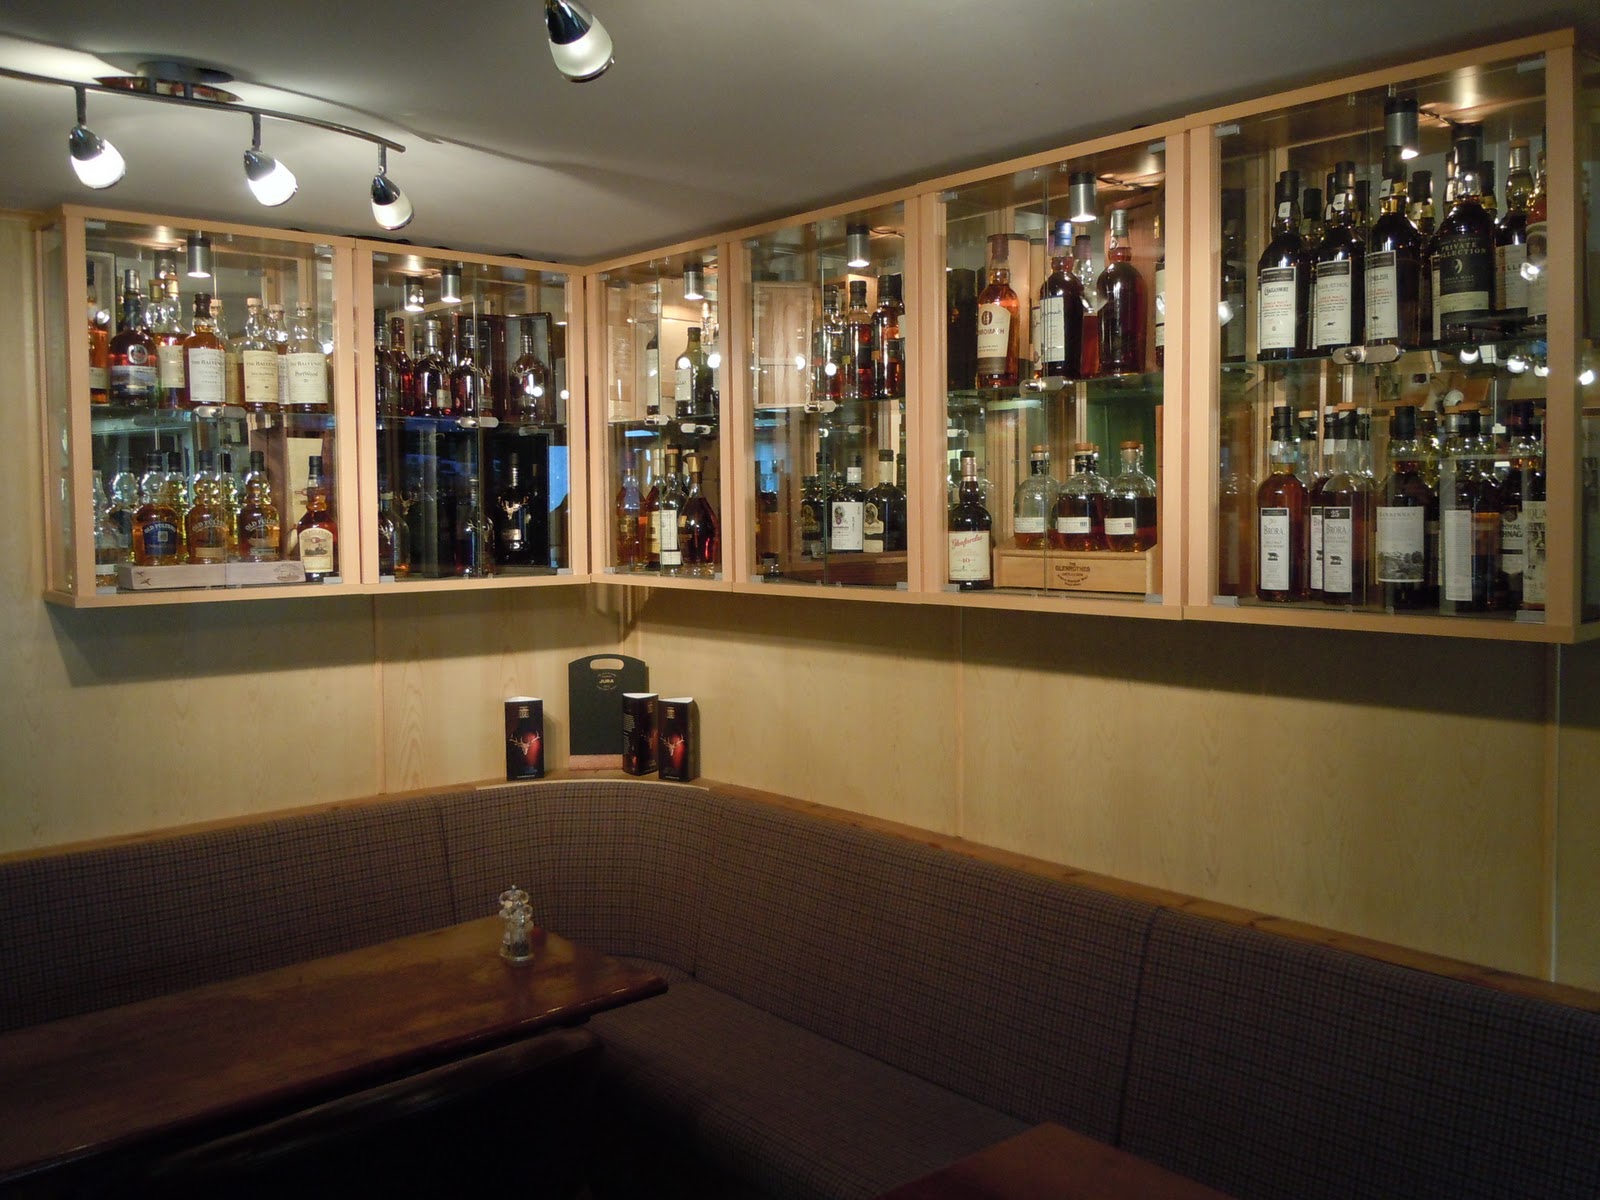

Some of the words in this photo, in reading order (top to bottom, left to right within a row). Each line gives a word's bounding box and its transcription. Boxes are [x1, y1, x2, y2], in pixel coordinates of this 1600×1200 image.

[1441, 241, 1477, 252] PRIVATE
[1330, 509, 1340, 518] 25
[144, 525, 155, 534] OLD
[192, 521, 204, 532] OLD
[245, 520, 257, 531] OLD
[1263, 525, 1284, 535] BRORA
[1325, 523, 1347, 534] BRORA
[951, 533, 983, 550] Glenfarclas
